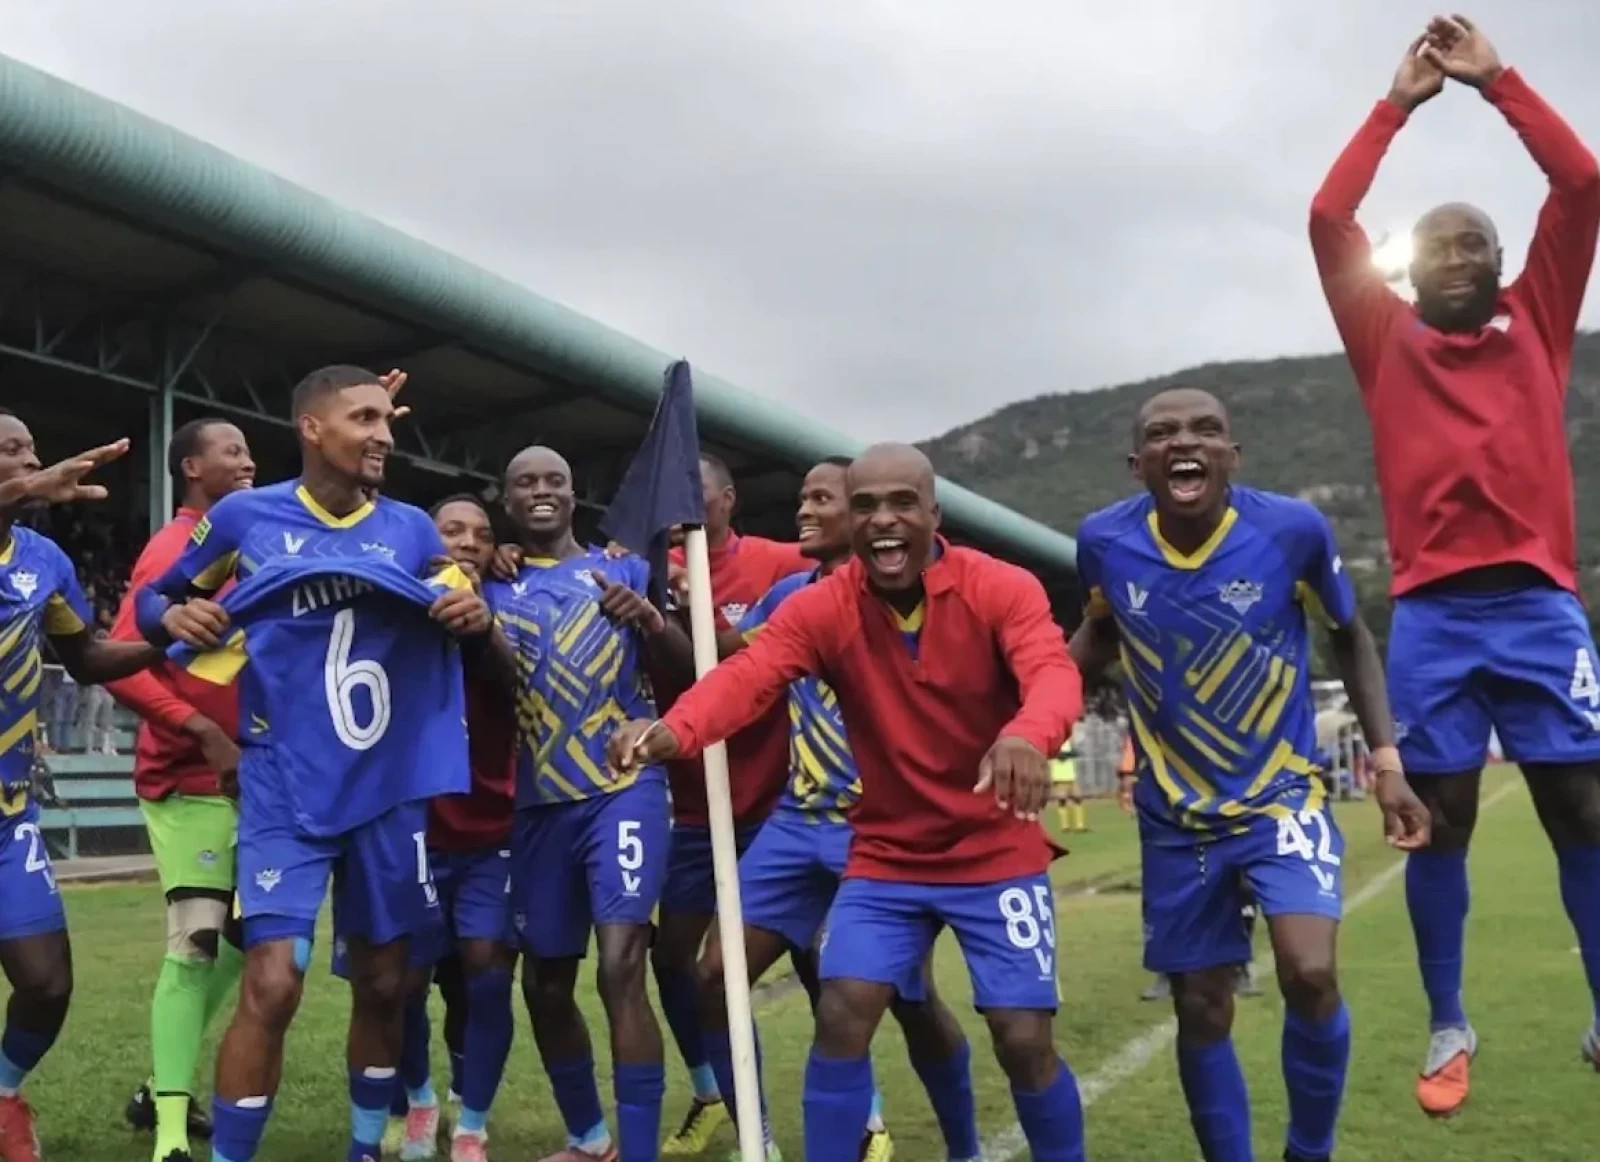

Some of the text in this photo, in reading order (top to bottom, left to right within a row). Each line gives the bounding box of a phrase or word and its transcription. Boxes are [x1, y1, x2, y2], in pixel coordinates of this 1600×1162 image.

[325, 608, 391, 750] 6
[1570, 648, 1600, 708] 4
[14, 823, 53, 873] 2
[618, 820, 643, 870] 5
[1277, 810, 1340, 866] 42
[998, 886, 1055, 949] 85
